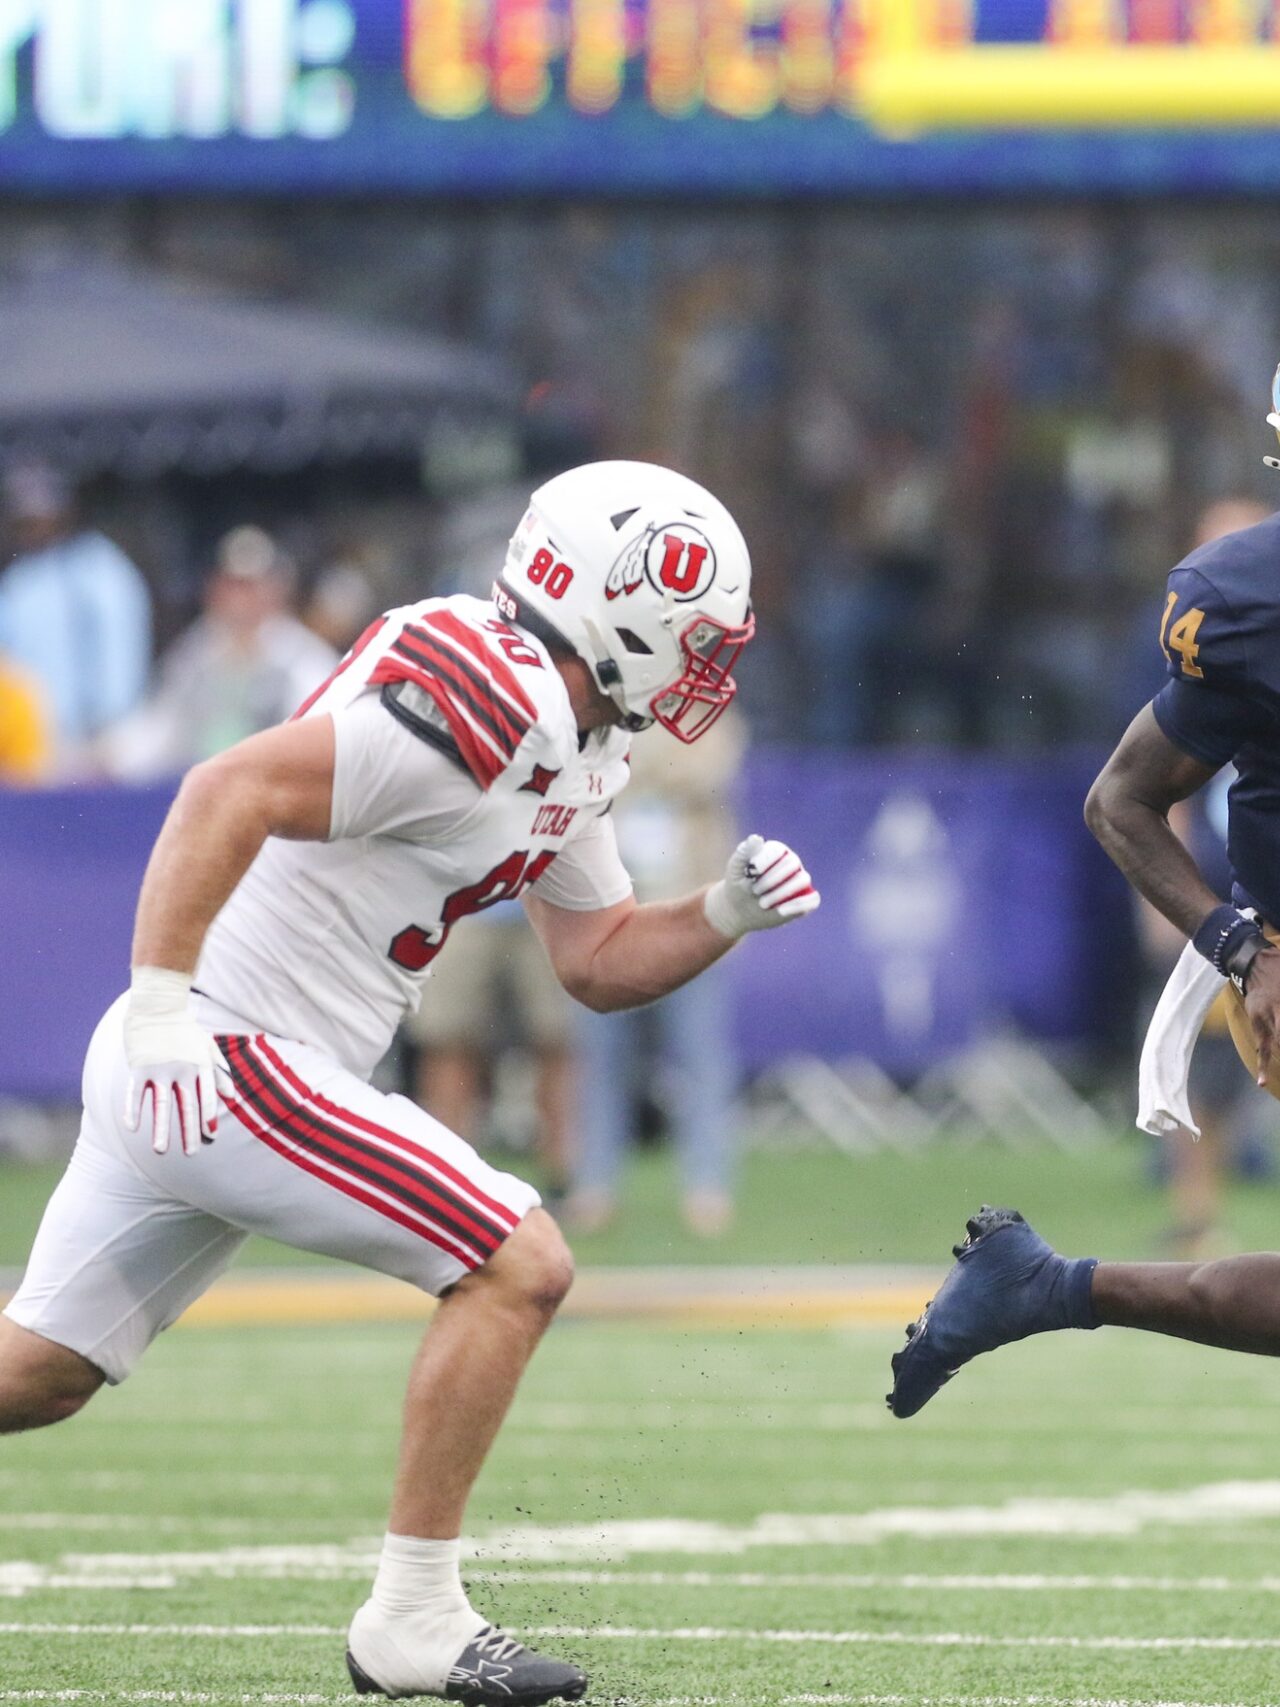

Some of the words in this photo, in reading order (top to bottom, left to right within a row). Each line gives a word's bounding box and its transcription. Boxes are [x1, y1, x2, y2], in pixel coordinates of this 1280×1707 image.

[659, 533, 708, 594] U
[1159, 591, 1206, 680] 14
[530, 804, 578, 837] UTAH
